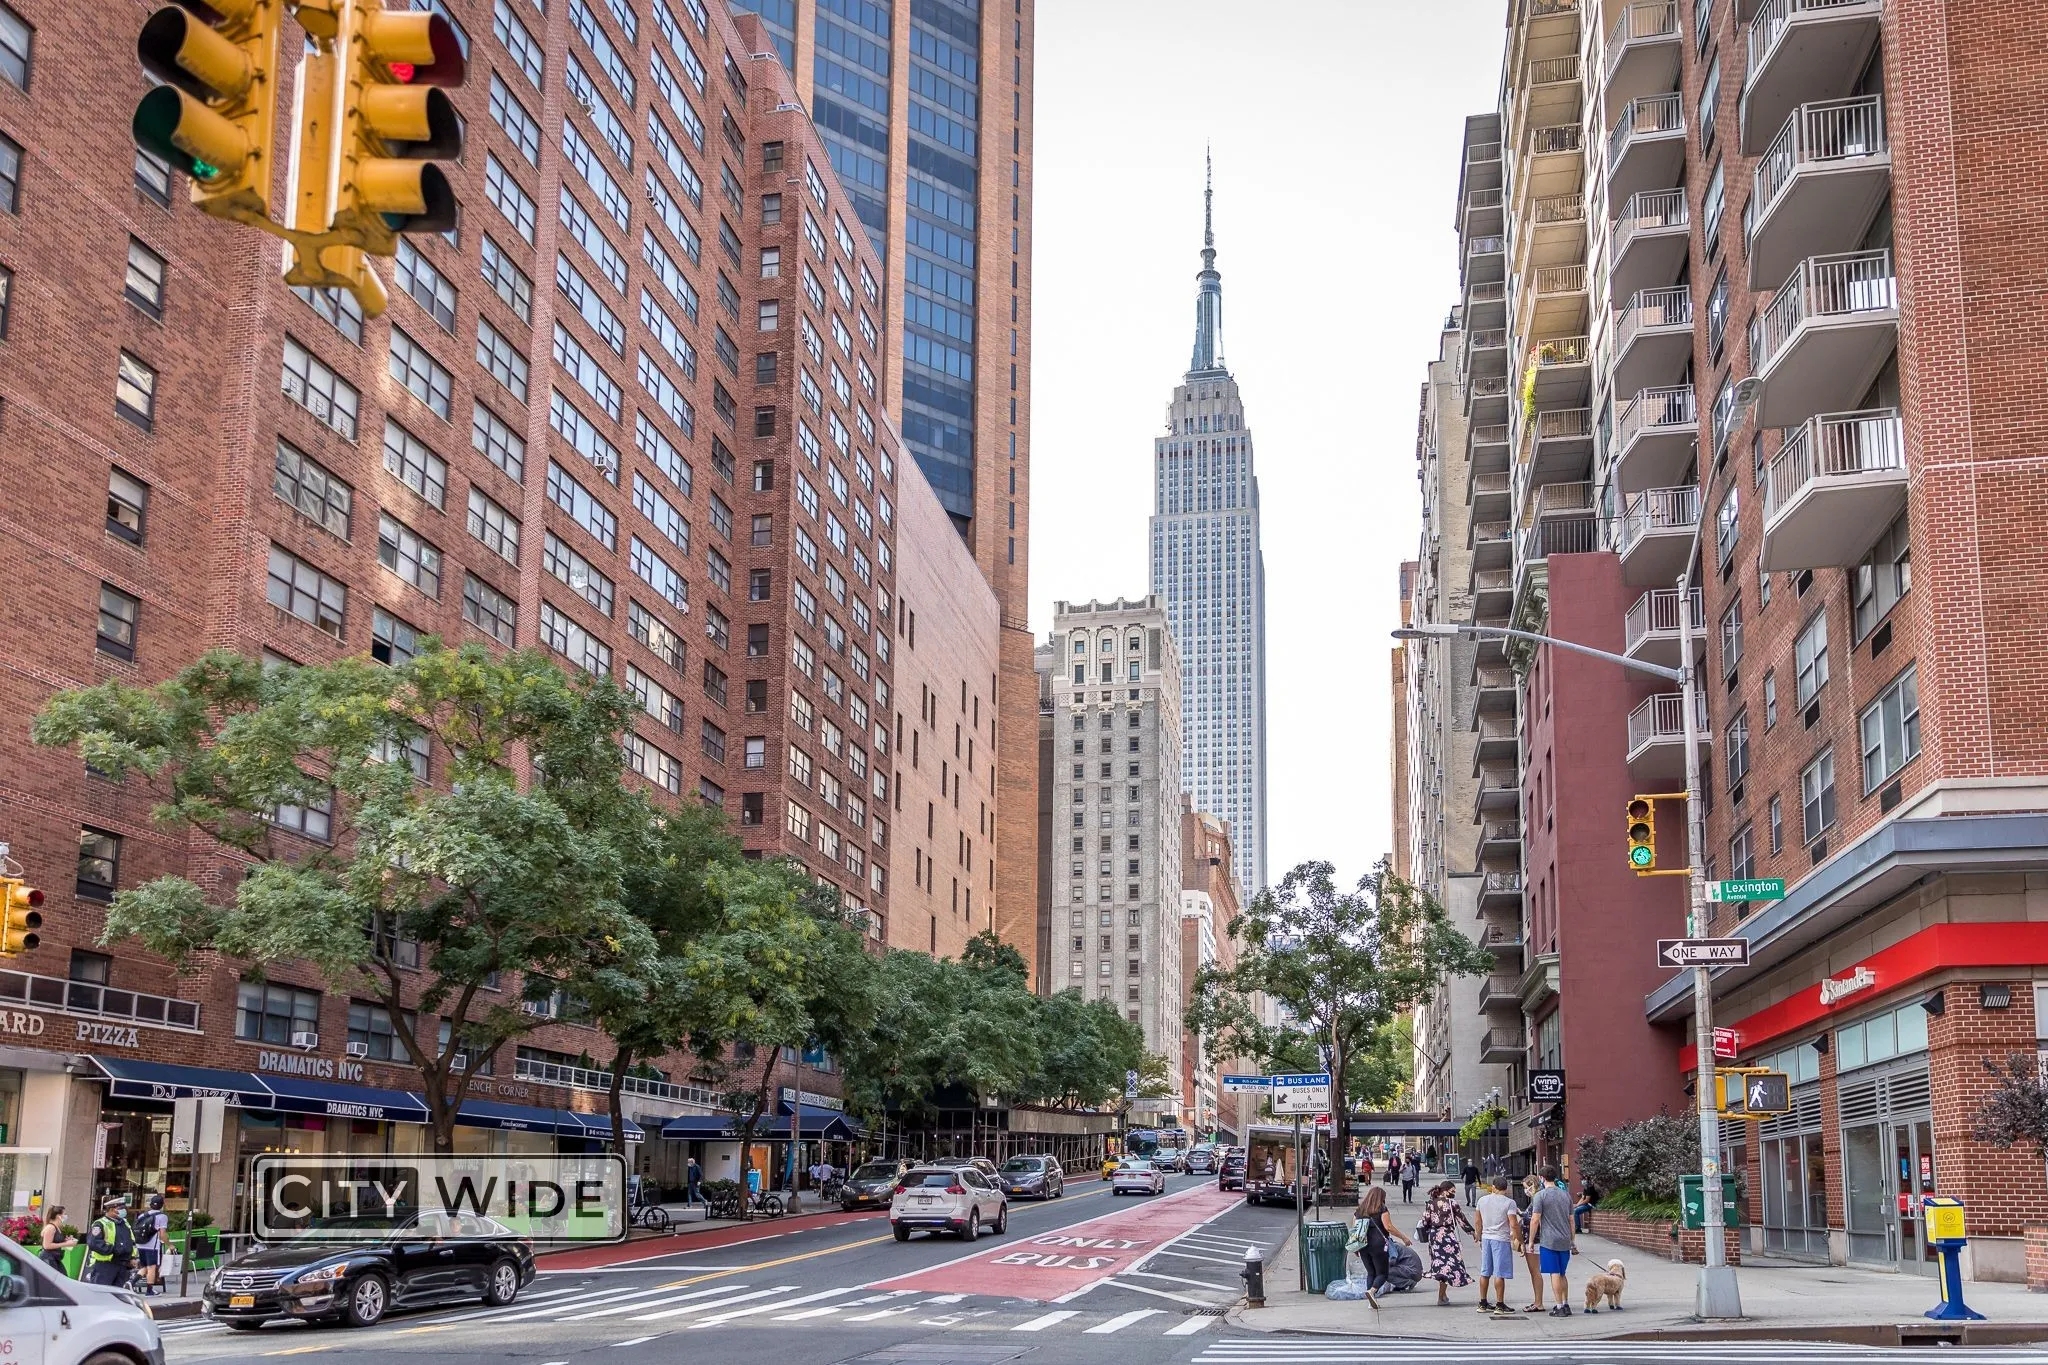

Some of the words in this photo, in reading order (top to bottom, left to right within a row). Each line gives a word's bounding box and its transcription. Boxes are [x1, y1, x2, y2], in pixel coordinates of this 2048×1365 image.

[1725, 881, 1779, 895] Lexington
[1672, 947, 1697, 959] ONE
[1709, 946, 1736, 958] WAY
[1830, 967, 1876, 1000] Santander
[75, 1020, 140, 1048] PIZZA
[258, 1051, 334, 1078] DRAMATICS
[338, 1062, 363, 1082] NYC
[1287, 1077, 1303, 1085] BUS
[1304, 1076, 1326, 1084] LANE
[152, 1084, 178, 1099] DJ
[467, 1080, 492, 1093] ENCH
[498, 1084, 529, 1098] CORNER
[326, 1102, 367, 1117] DRAMATICS
[368, 1107, 384, 1118] NYC
[1031, 1236, 1152, 1249] ONLY
[989, 1252, 1116, 1270] BUS
